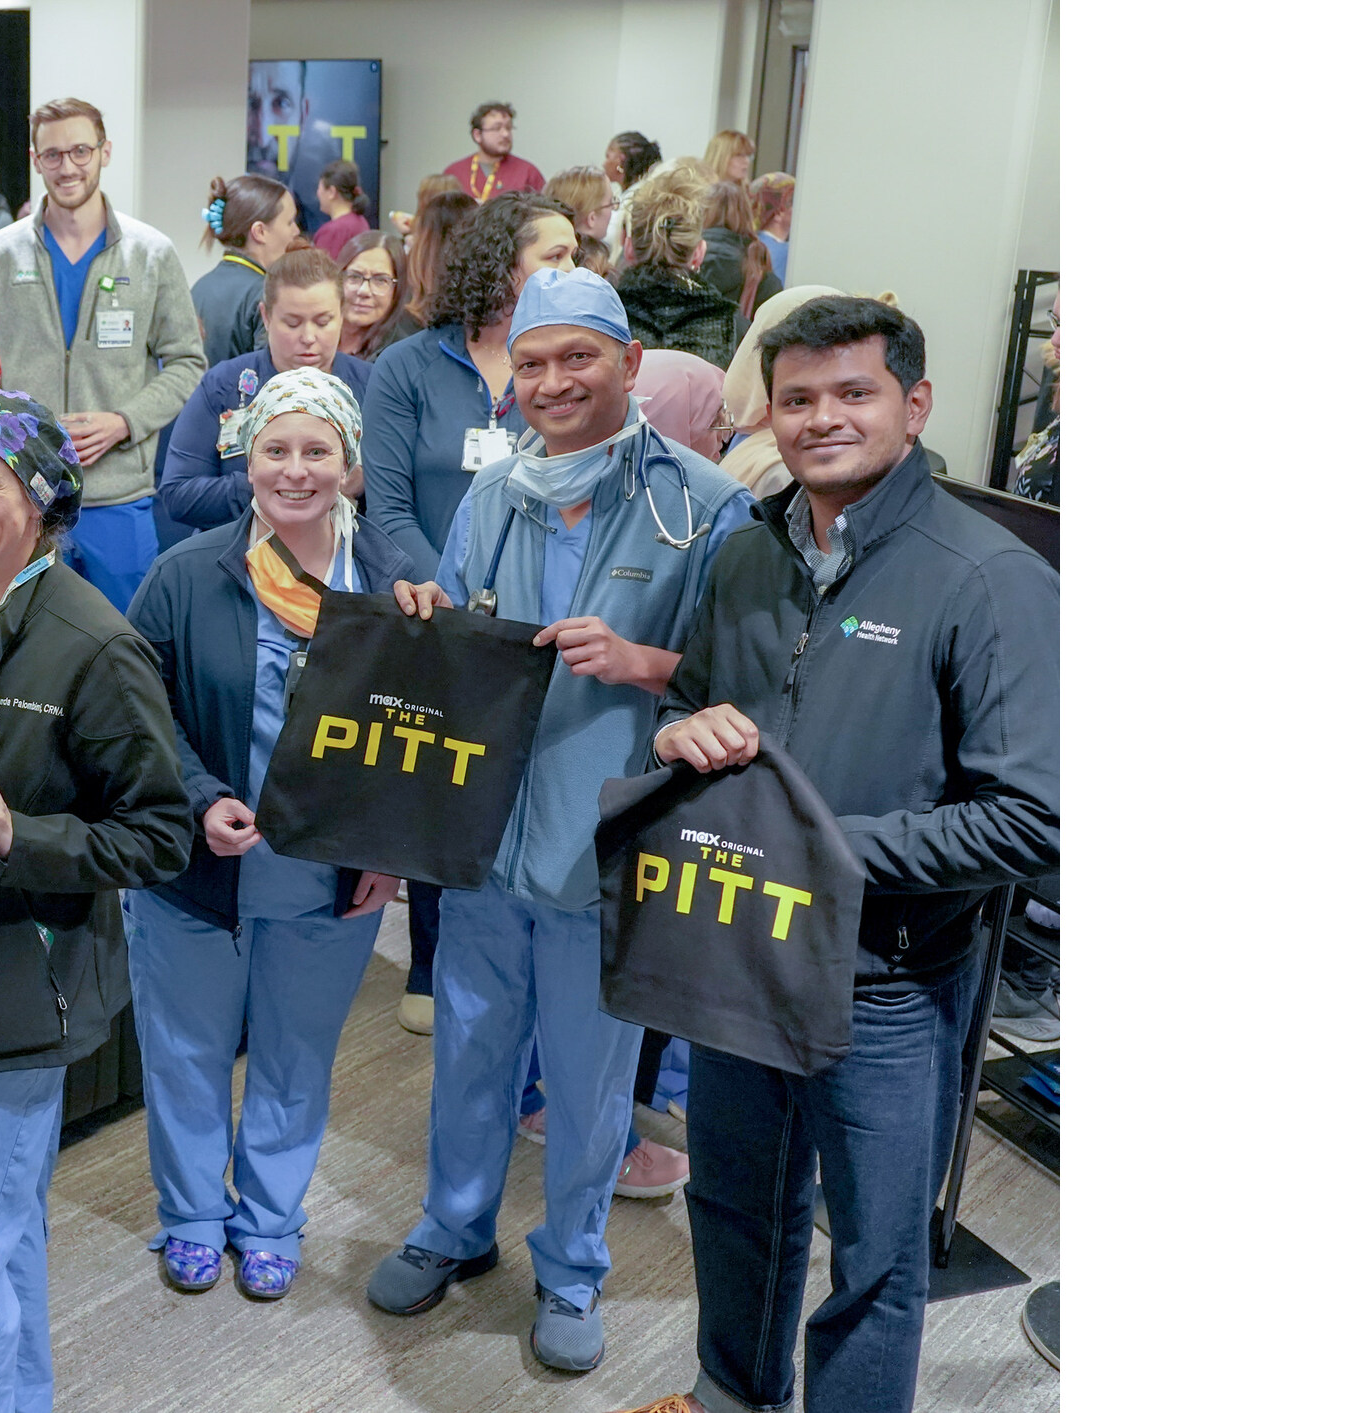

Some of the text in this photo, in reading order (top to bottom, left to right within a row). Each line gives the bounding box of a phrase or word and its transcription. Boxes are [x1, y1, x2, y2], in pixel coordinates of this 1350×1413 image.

[617, 569, 651, 580] Columbia
[856, 630, 899, 646] Health Network
[859, 620, 902, 638] Allegheny
[369, 693, 444, 718] max ORIGINAL
[385, 708, 426, 726] THE
[311, 714, 486, 786] PITT
[680, 828, 765, 858] max ORIGINAL
[700, 846, 744, 868] THE
[635, 851, 813, 941] PITT
